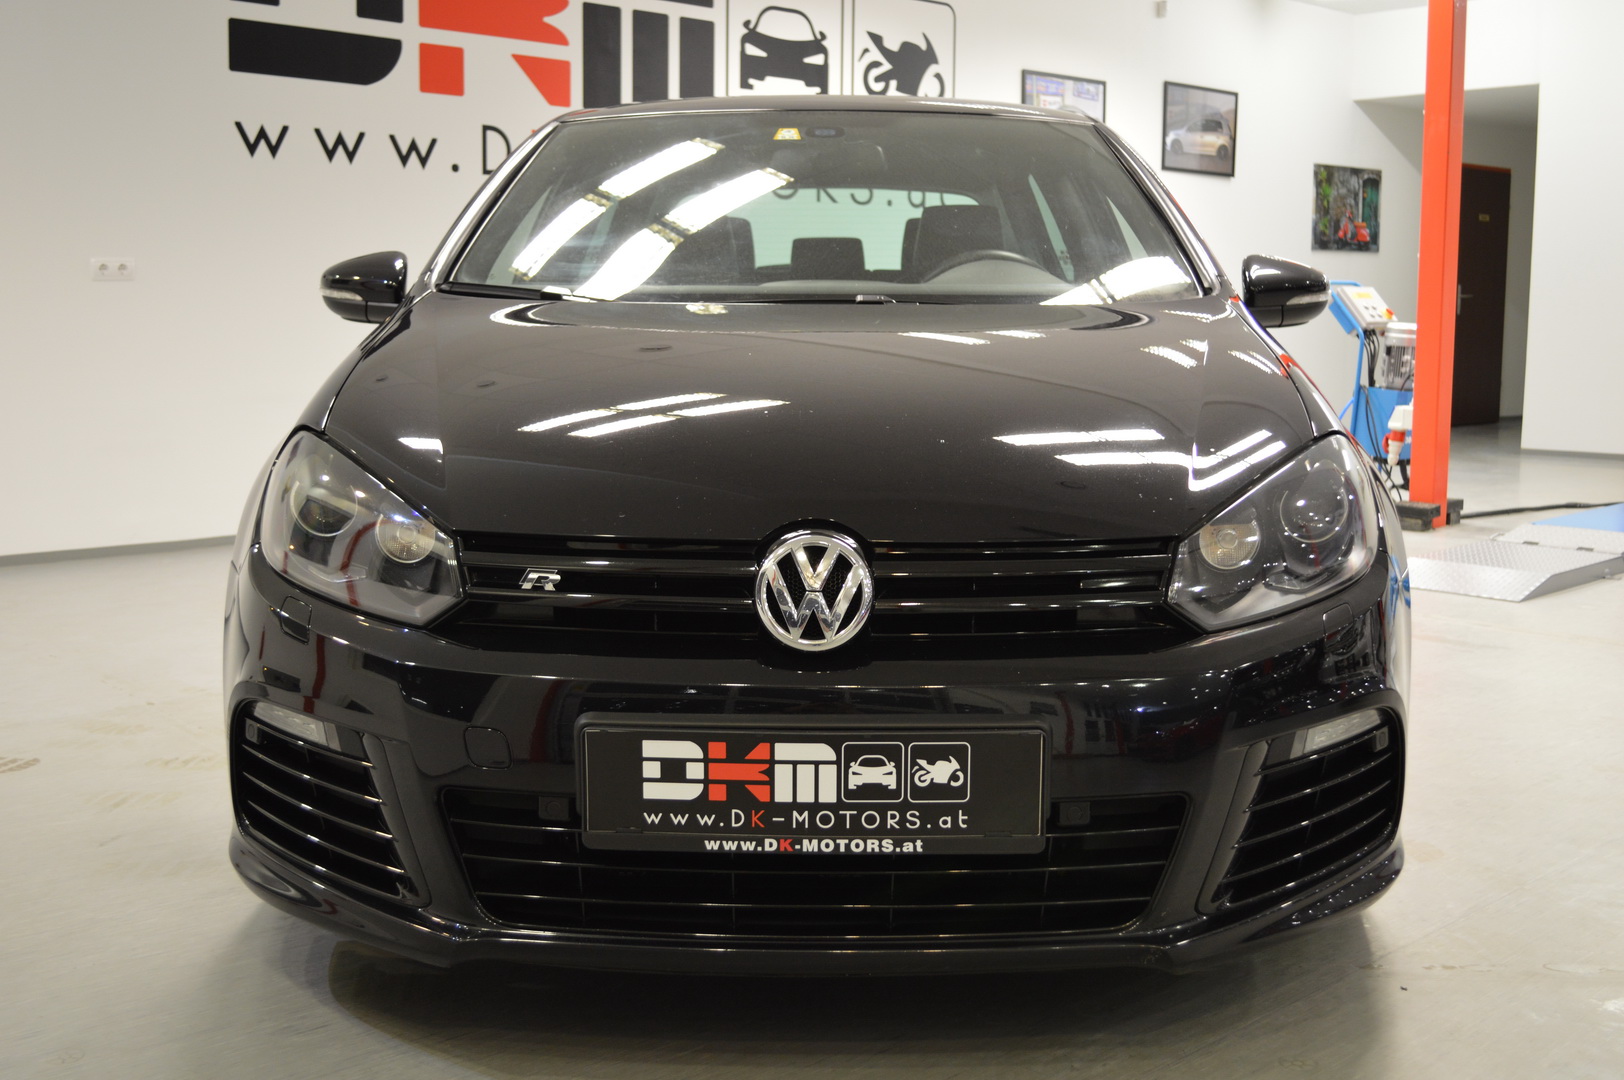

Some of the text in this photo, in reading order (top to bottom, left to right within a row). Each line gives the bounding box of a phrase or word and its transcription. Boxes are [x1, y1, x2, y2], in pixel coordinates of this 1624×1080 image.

[234, 121, 514, 175] www.D
[519, 567, 561, 591] R
[760, 536, 870, 646] VW
[641, 739, 839, 803] DKM
[643, 809, 969, 831] www.DK-MOTORS.at
[704, 838, 924, 853] www.DK-MOTORS.at
